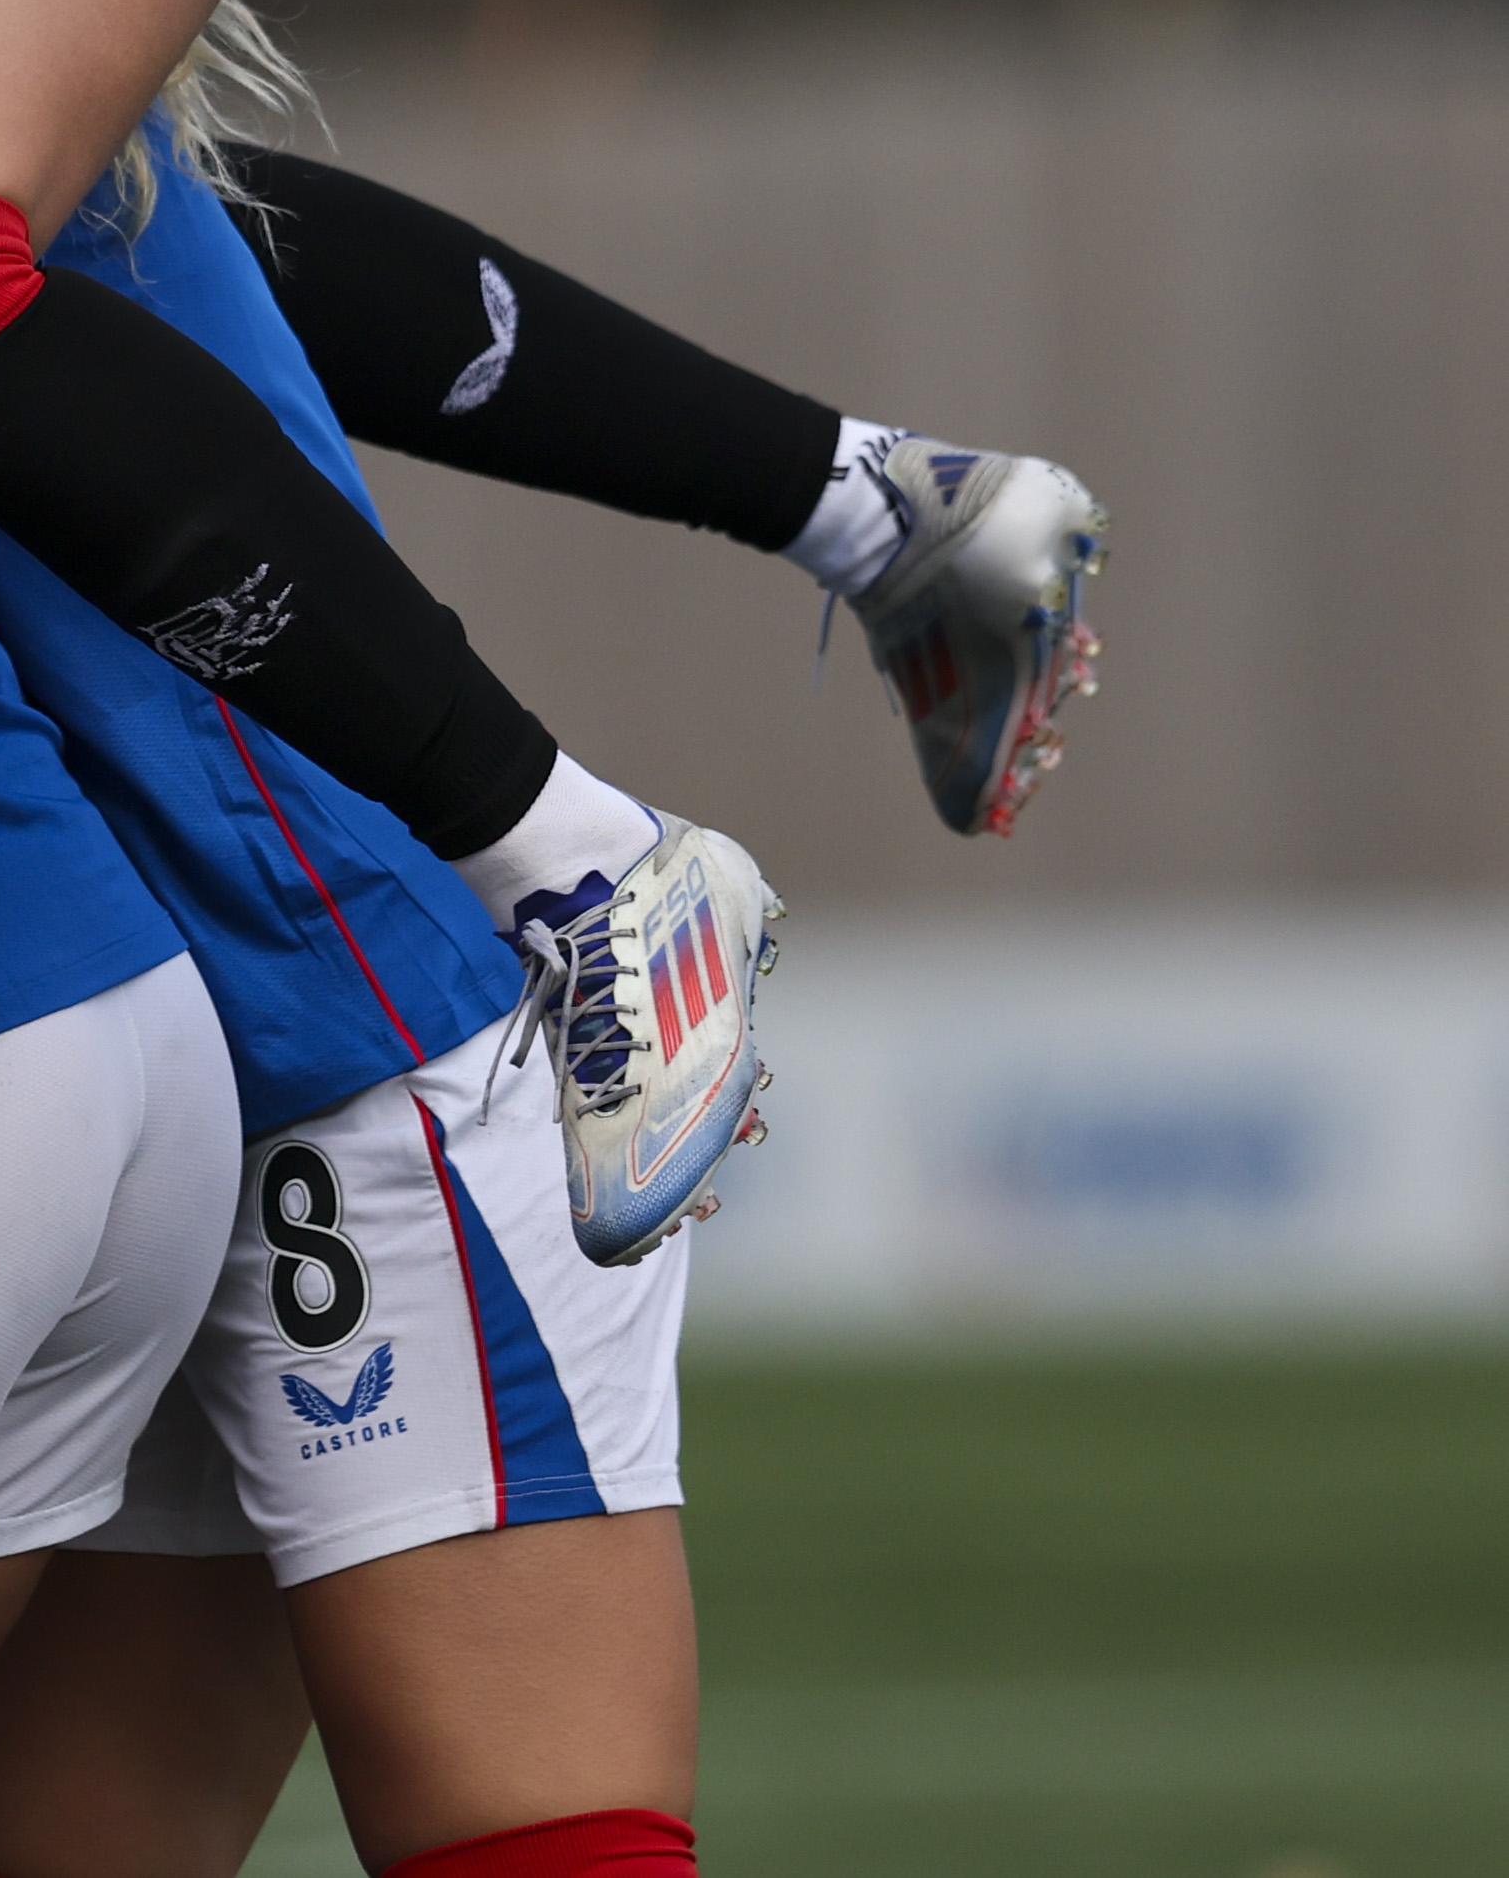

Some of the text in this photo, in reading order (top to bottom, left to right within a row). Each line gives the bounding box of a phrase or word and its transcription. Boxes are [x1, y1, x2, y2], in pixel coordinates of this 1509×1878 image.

[644, 856, 706, 956] F50
[258, 1140, 371, 1354] 8
[300, 1417, 408, 1460] CASTORE
